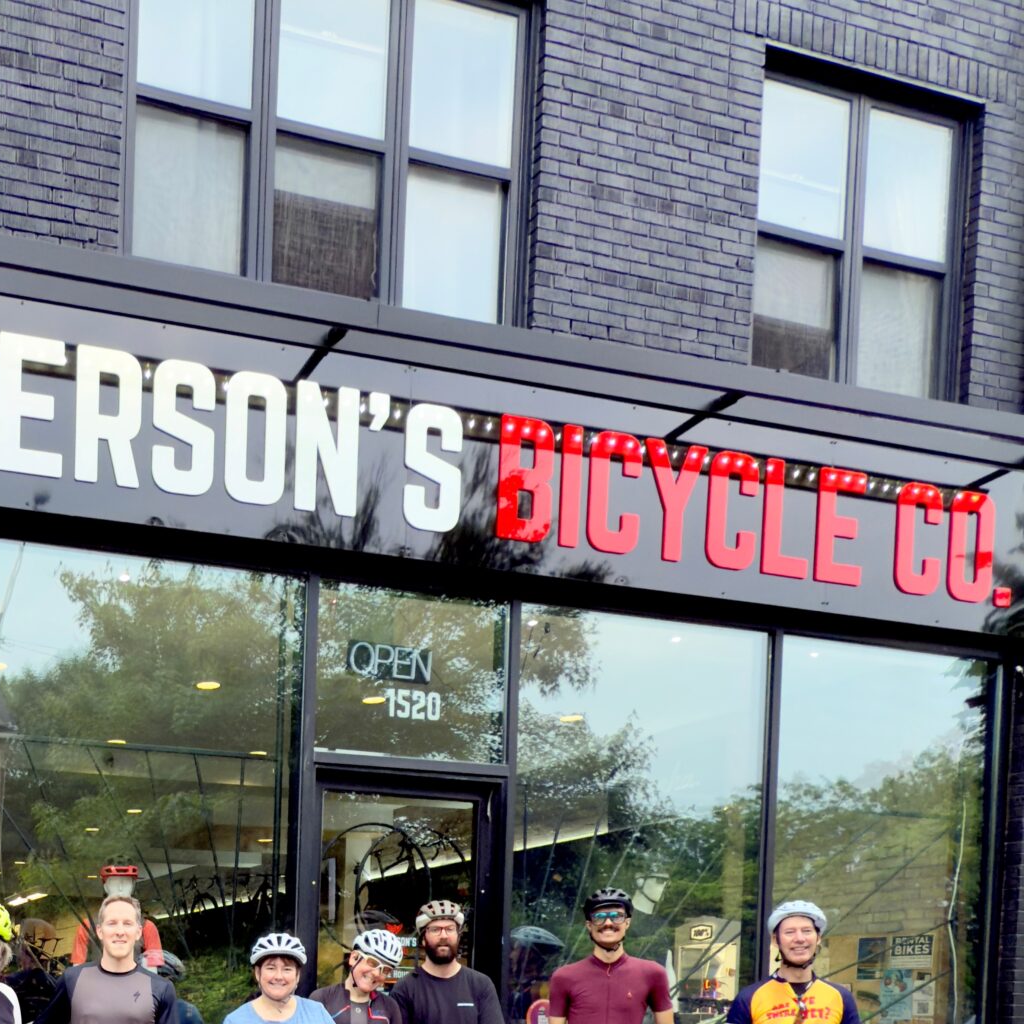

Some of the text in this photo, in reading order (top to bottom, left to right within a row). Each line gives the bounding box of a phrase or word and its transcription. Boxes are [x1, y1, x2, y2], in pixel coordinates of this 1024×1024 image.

[496, 413, 869, 587] BICYCLE
[893, 481, 1012, 608] CO.
[350, 642, 433, 682] OPEN
[385, 688, 441, 720] 1520
[894, 944, 931, 955] BIKES
[895, 935, 931, 946] RENTAL
